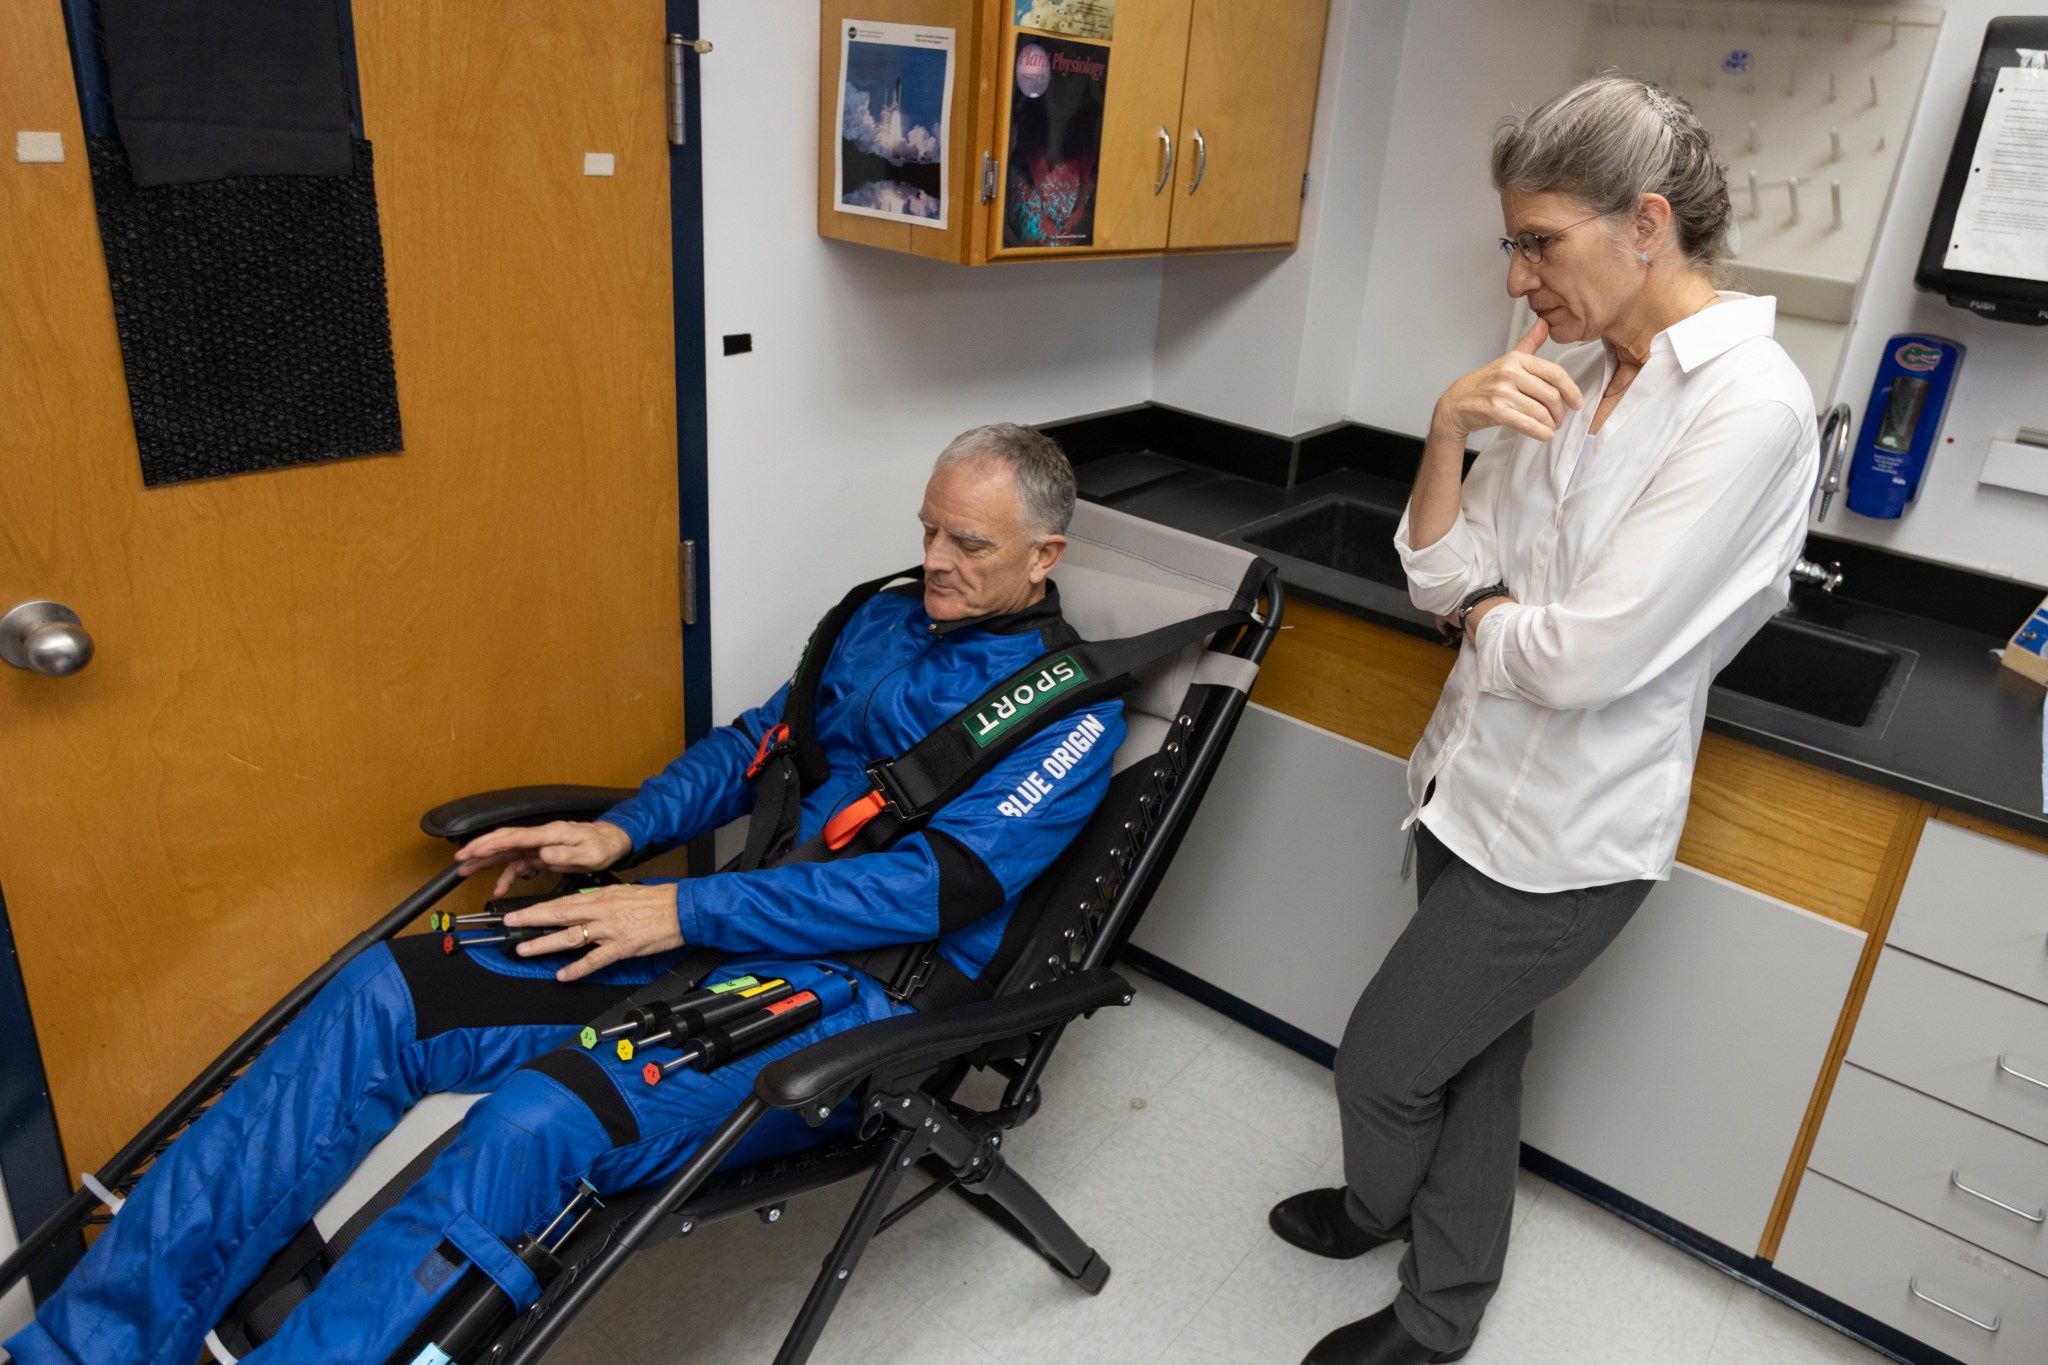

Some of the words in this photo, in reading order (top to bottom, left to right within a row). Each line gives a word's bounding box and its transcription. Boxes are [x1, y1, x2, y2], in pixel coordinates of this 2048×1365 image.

[1019, 47, 1051, 68] Plant
[1052, 51, 1105, 81] Physiology
[1969, 300, 1997, 311] PUSH
[976, 661, 1075, 737] SPORT
[996, 771, 1054, 818] BLUE
[1042, 713, 1106, 780] ORIGIN
